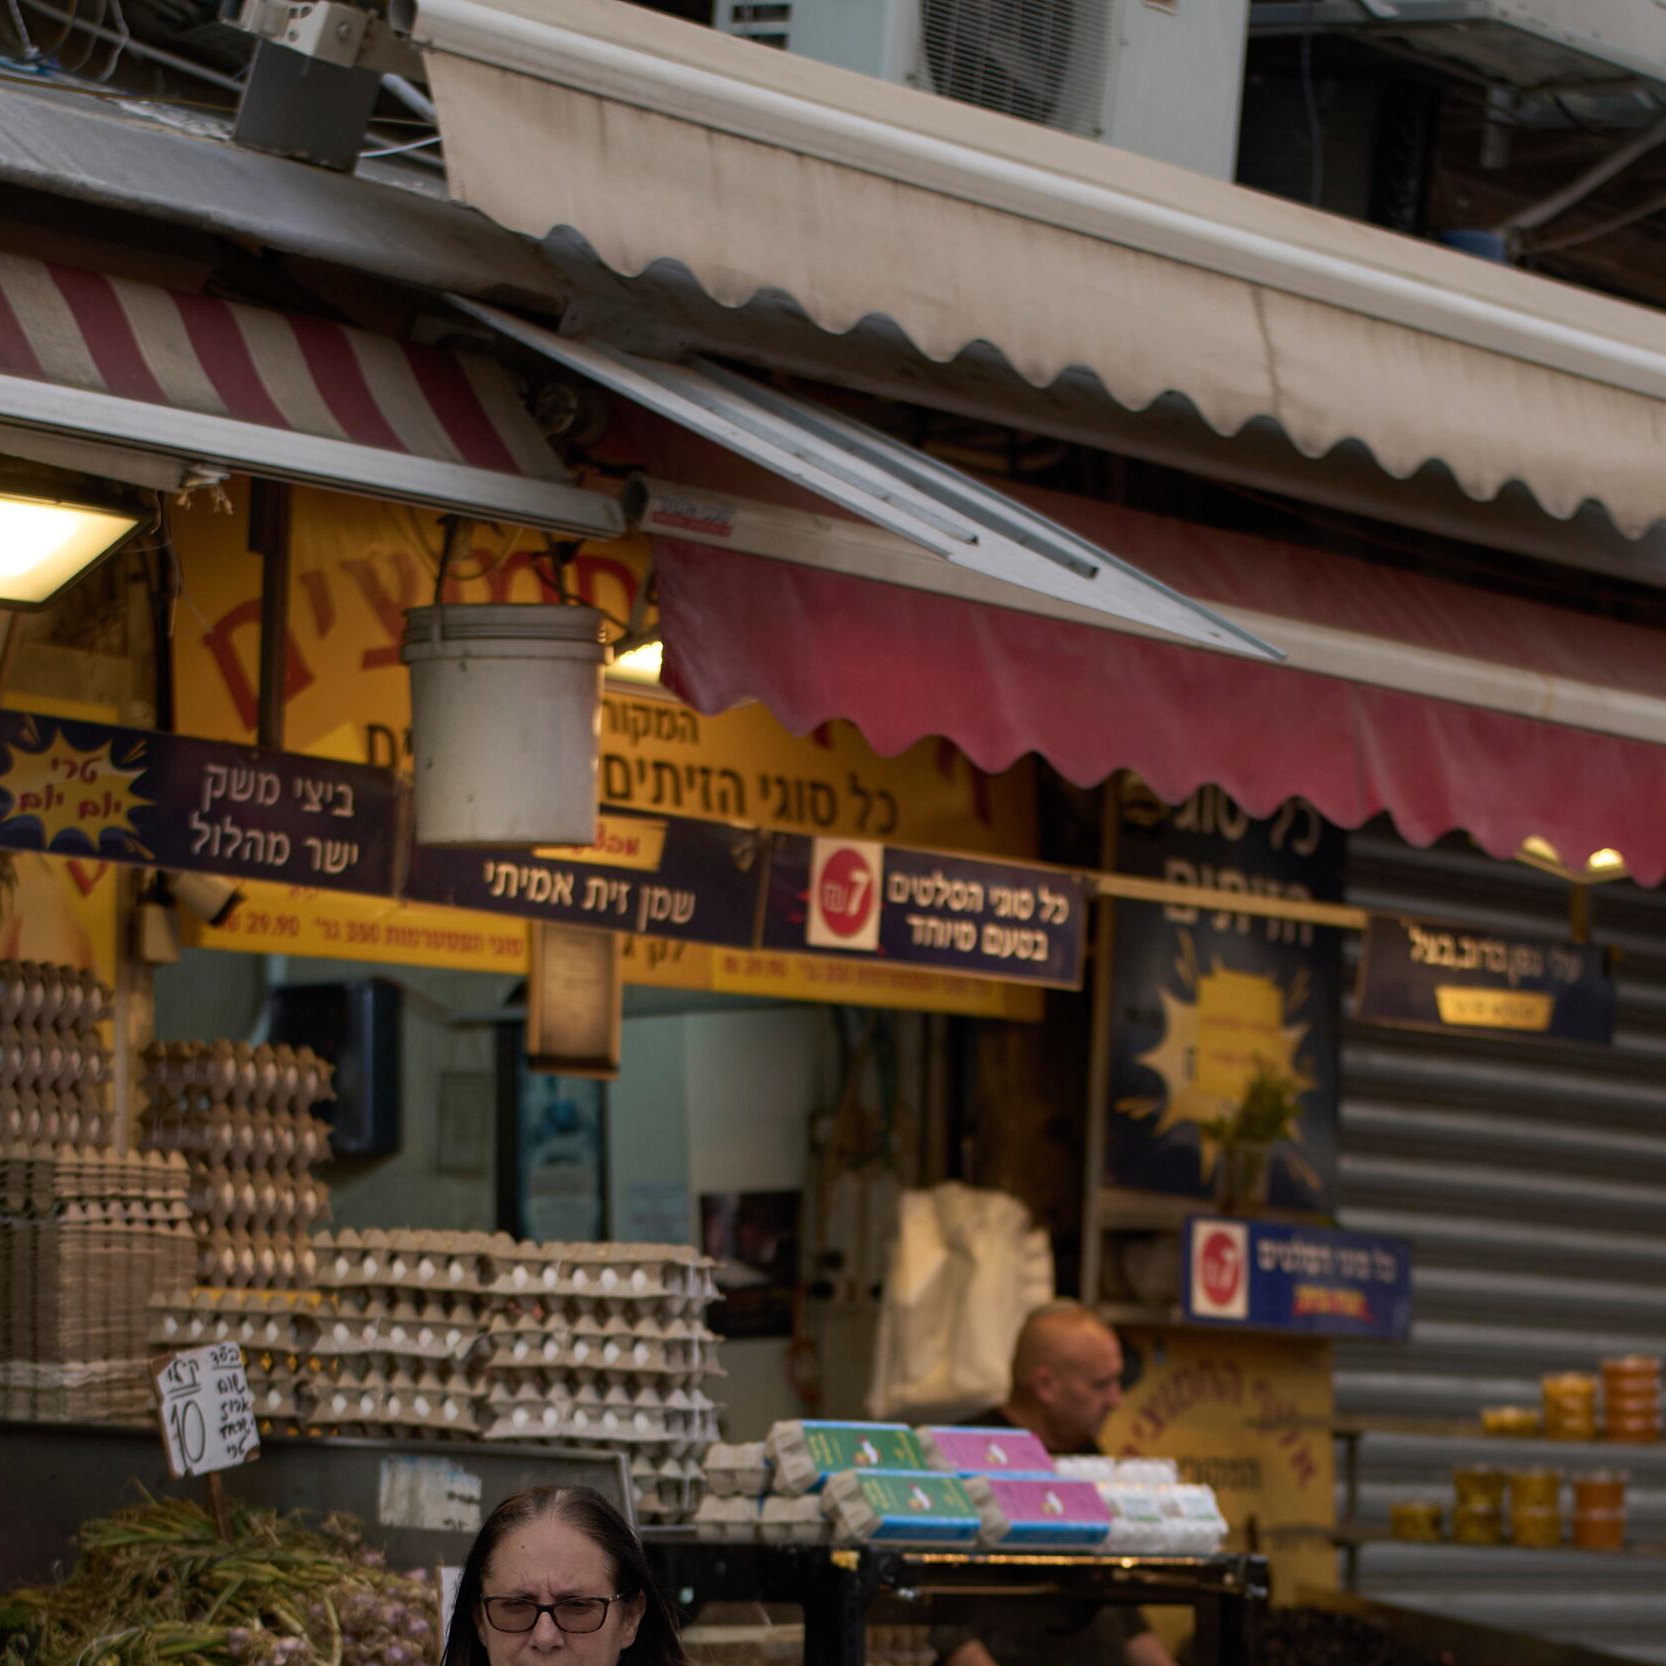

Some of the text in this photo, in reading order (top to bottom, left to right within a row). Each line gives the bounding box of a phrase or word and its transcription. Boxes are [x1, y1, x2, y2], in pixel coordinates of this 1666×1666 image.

[50, 755, 102, 785] טרי
[200, 761, 356, 819] ביצי משק
[601, 753, 748, 817] הזיתים
[759, 769, 840, 829] סוגי
[19, 783, 122, 820] יום יום
[848, 771, 900, 836] כל
[188, 810, 360, 875] ישר מהלול
[246, 911, 301, 937] 29.90
[483, 861, 696, 933] שמן זית אמיתי
[886, 869, 1070, 926] כל סוגי הסלטים
[171, 1399, 206, 1474] 10
